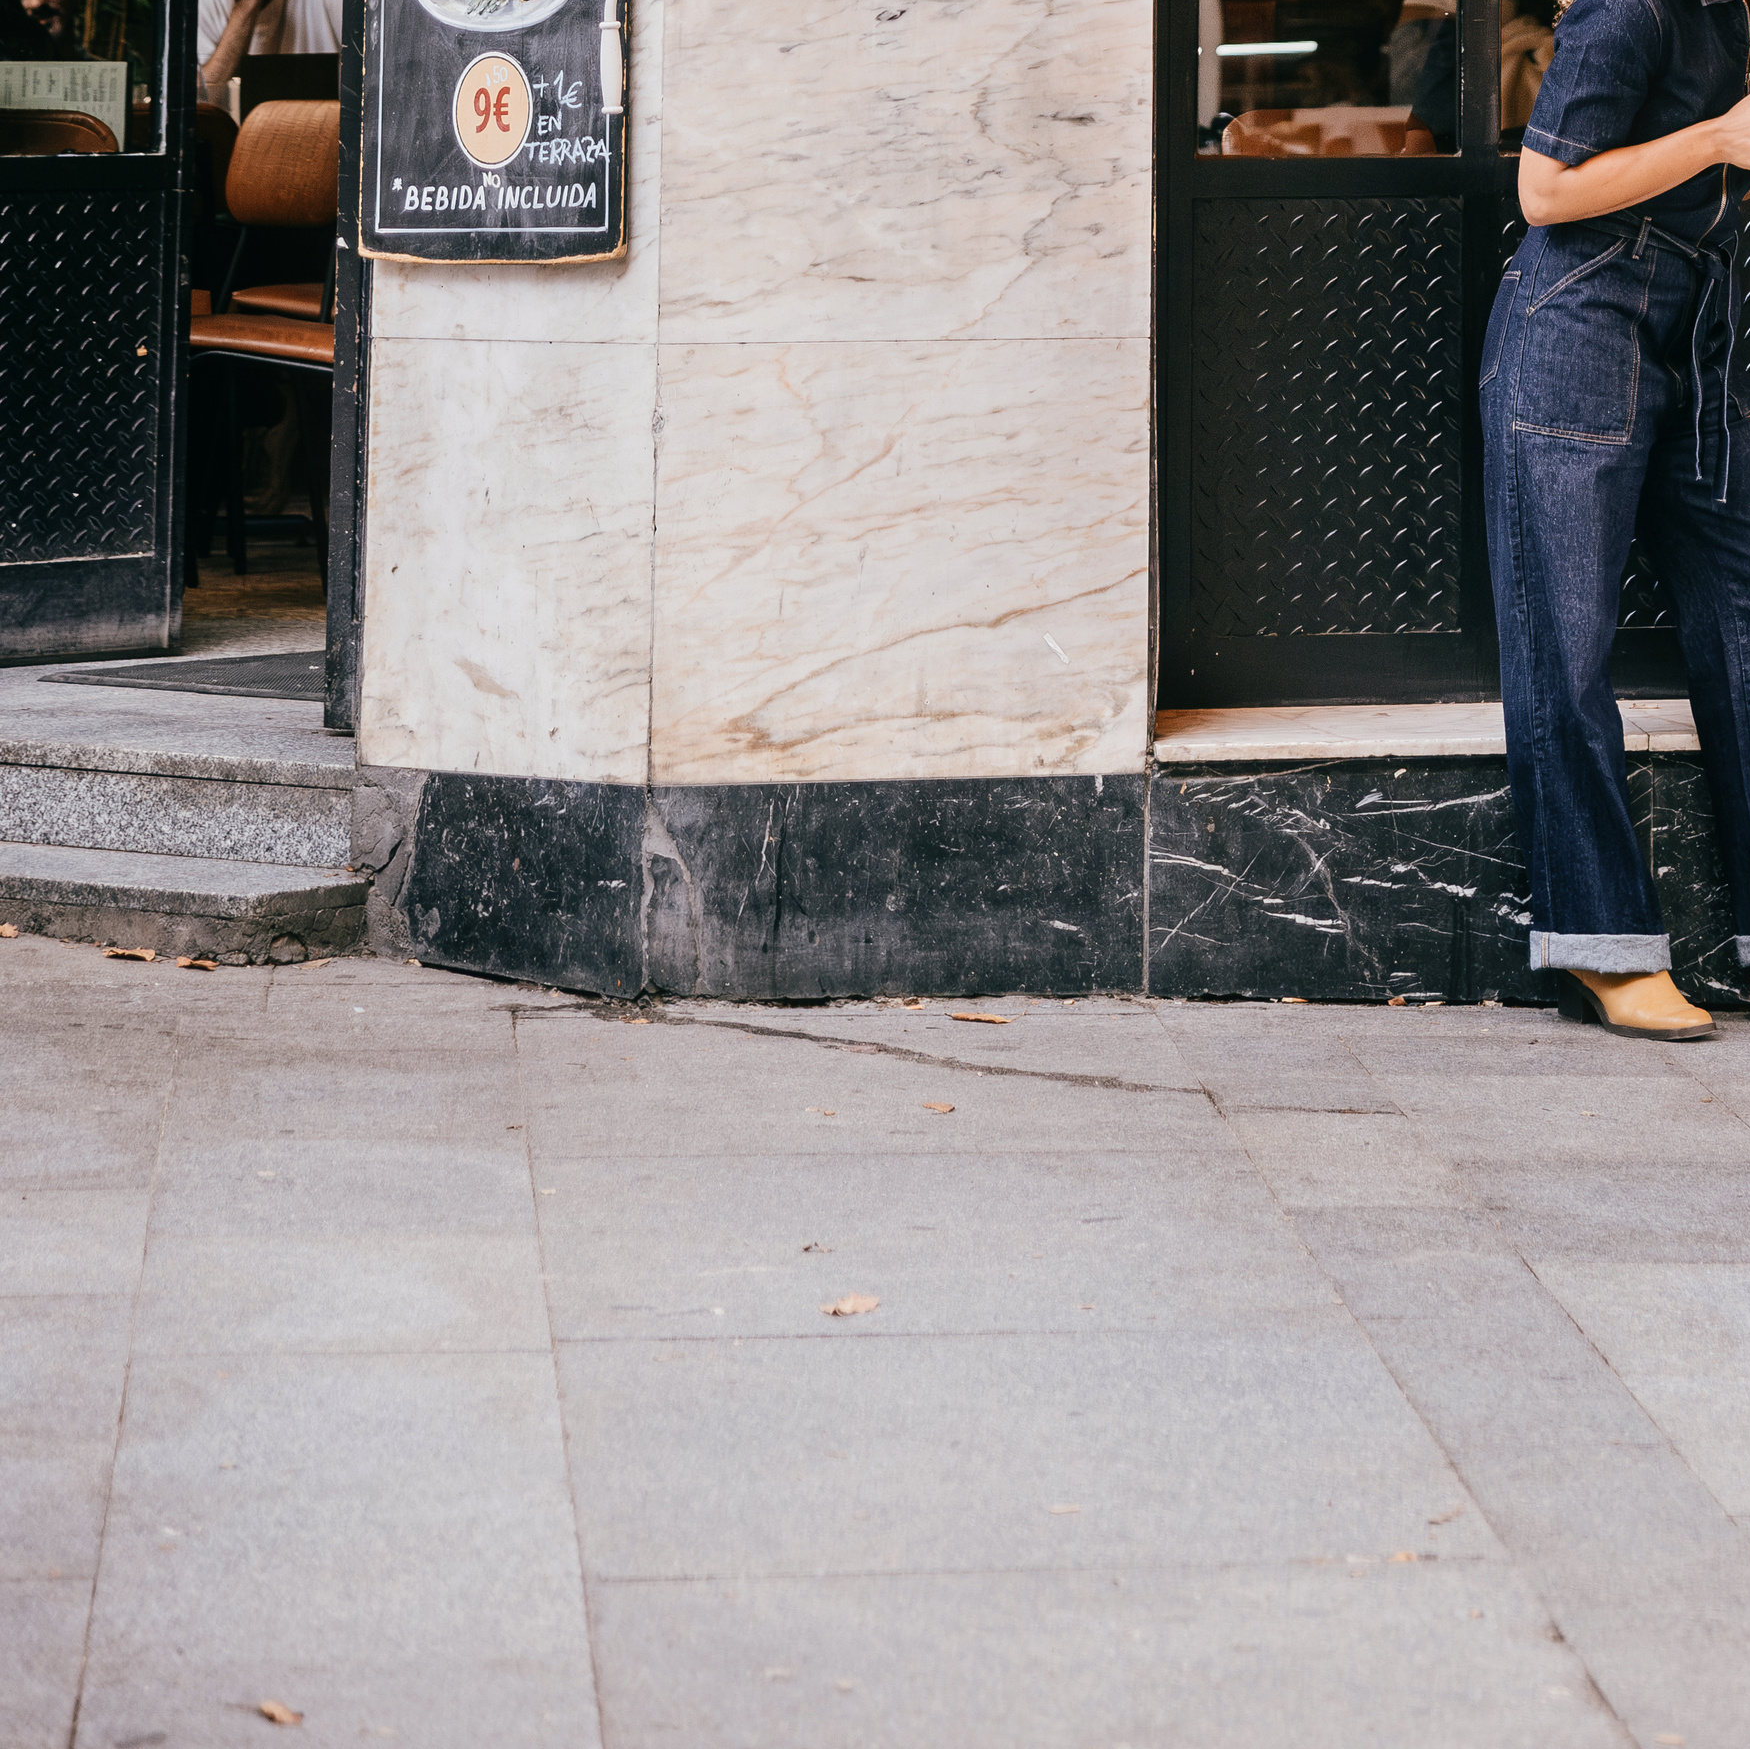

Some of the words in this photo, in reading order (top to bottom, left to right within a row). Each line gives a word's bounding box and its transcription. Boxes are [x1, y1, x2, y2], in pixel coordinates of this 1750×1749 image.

[473, 86, 511, 134] 9€
[537, 111, 563, 135] EN
[523, 136, 612, 166] TERRAZA
[482, 171, 501, 189] NO
[498, 182, 597, 210] INCLUIDA
